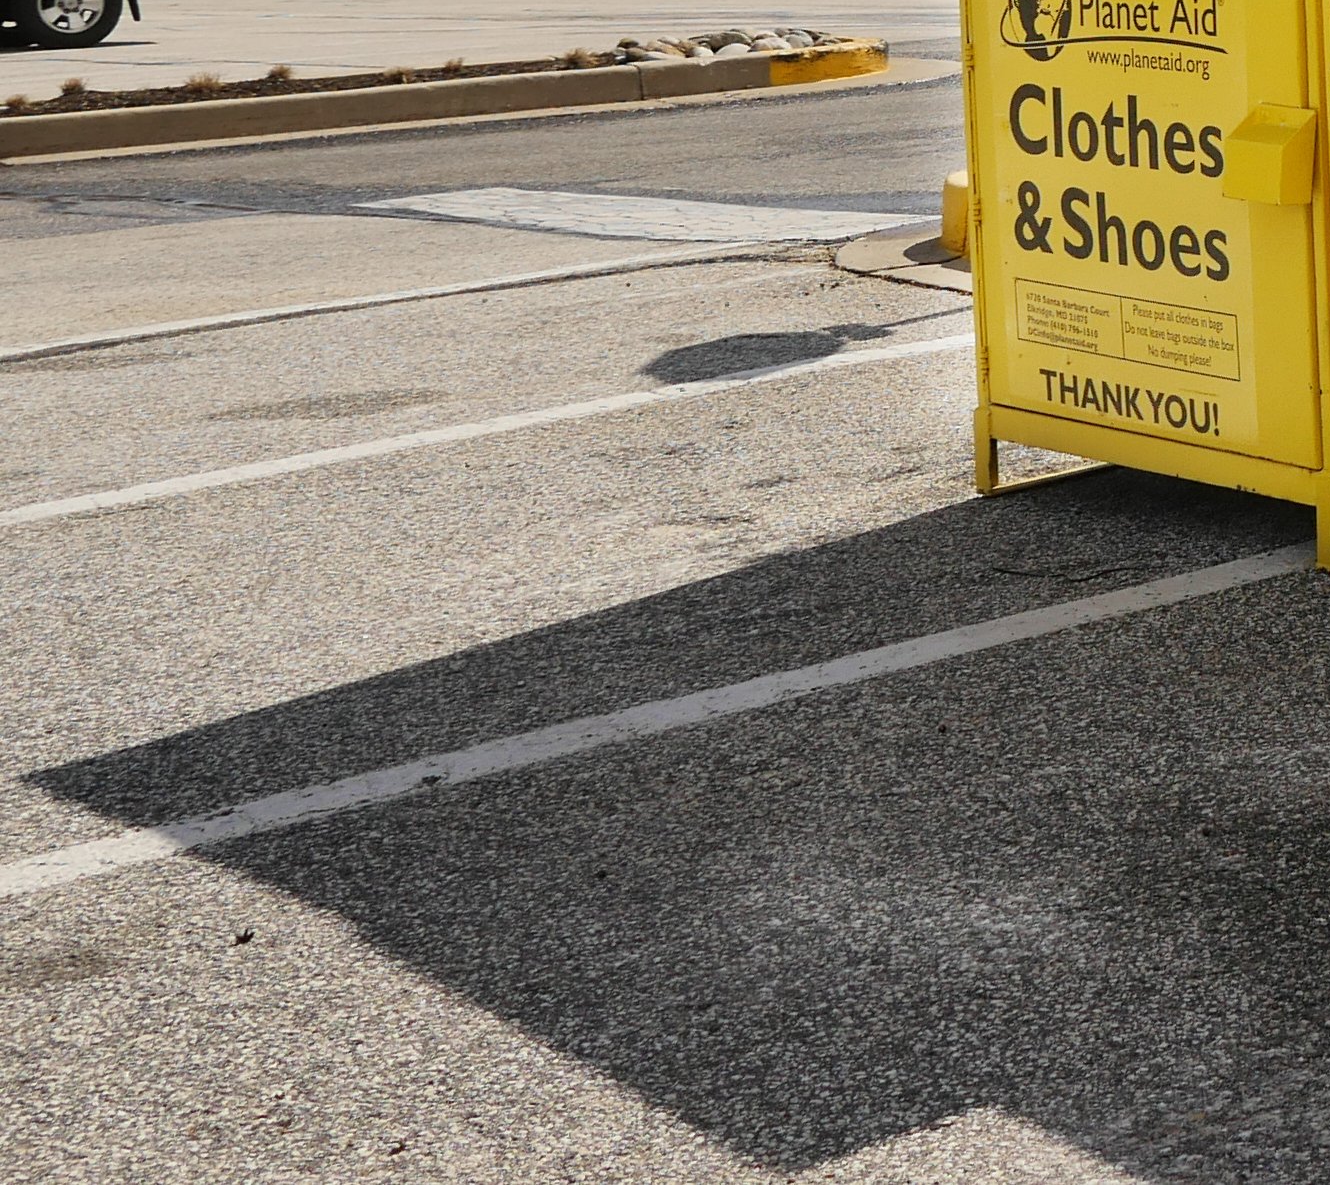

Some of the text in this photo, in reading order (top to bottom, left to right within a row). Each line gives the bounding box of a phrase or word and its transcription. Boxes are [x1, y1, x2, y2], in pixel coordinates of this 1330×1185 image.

[1087, 48, 1210, 80] www.planetaid.org
[1010, 84, 1223, 177] Clothes
[1015, 181, 1229, 281] & Shoes
[1039, 368, 1220, 438] THANK YOU!
